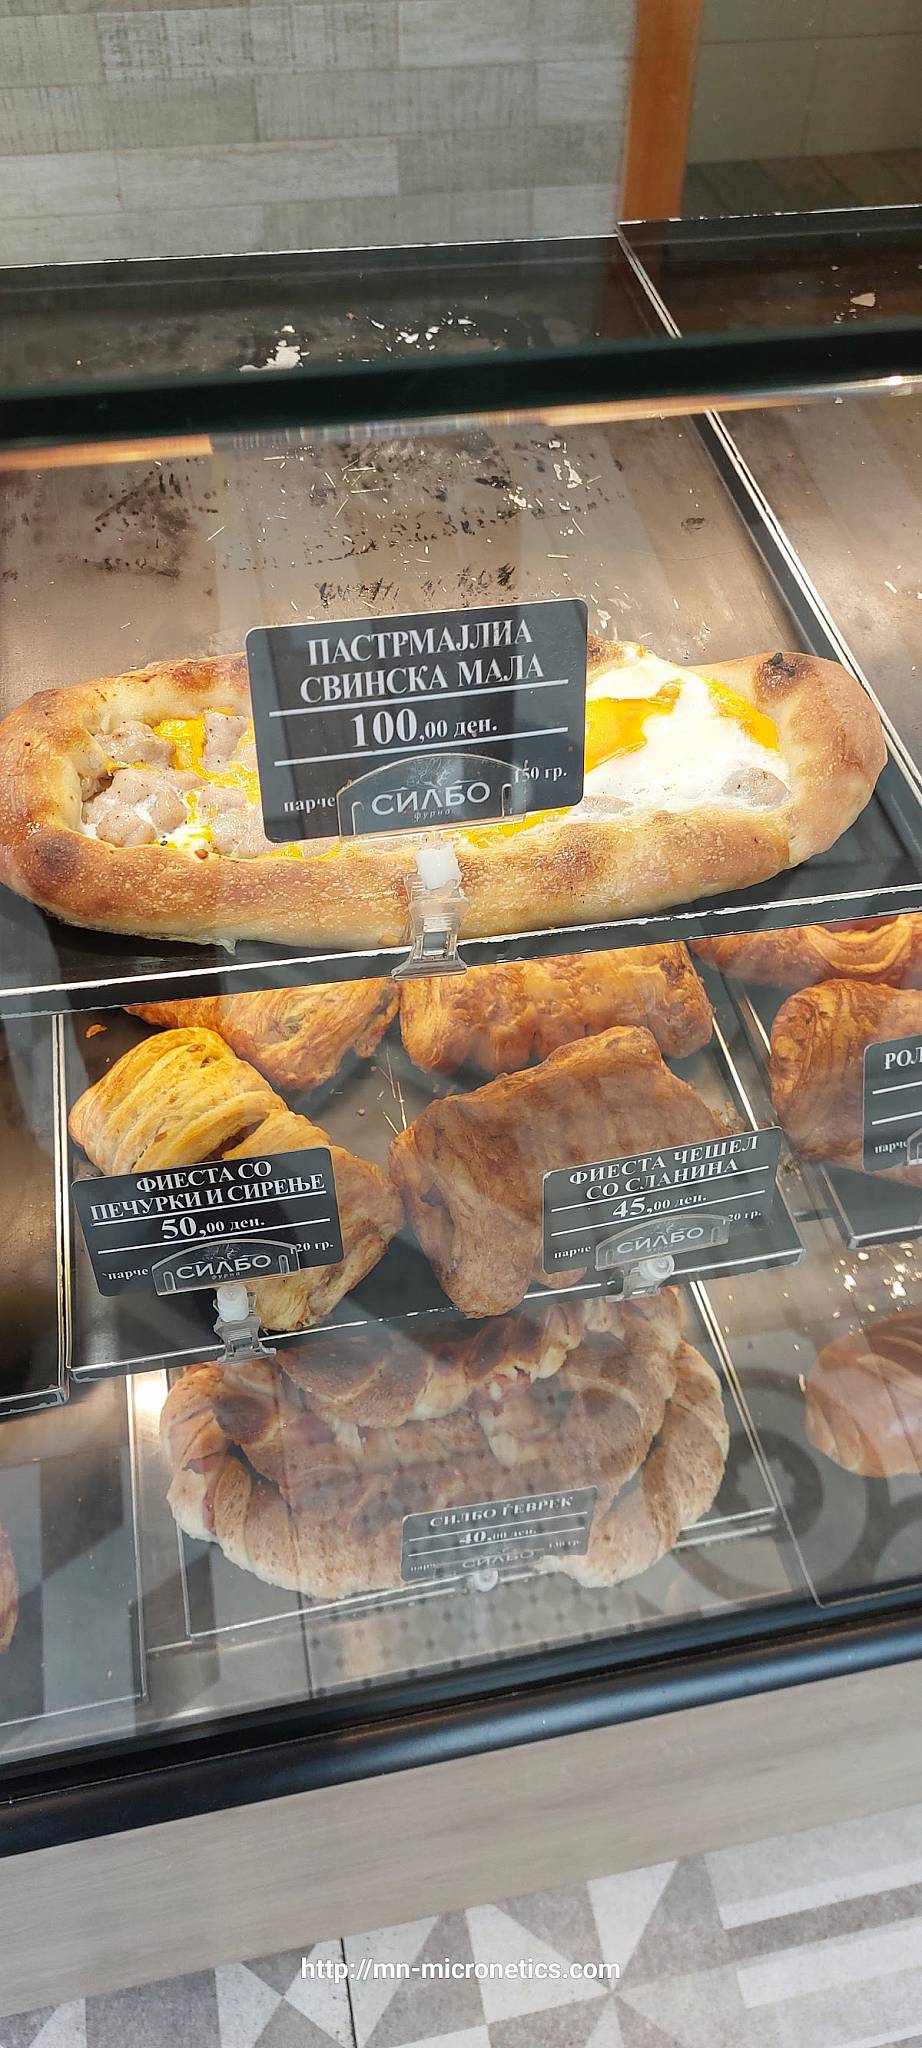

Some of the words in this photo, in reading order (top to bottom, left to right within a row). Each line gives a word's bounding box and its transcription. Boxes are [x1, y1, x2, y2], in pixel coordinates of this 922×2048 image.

[306, 619, 534, 666] ПАСТРМАЈЛИА
[300, 664, 449, 704] СВИНСКА
[457, 653, 545, 687] МАЛА
[352, 708, 448, 748] 100,00
[453, 717, 498, 738] ден.
[544, 765, 568, 782] гр.
[283, 796, 337, 816] парче
[371, 781, 491, 816] СИЛБО
[569, 1156, 667, 1186] ФИЕСТА
[673, 1135, 759, 1164] ЧЕШЕЛ
[136, 1168, 236, 1194] ФИЕСТА
[238, 1160, 272, 1180] СО
[586, 1182, 619, 1200] СО
[625, 1159, 739, 1193] СЛАНИНА
[90, 1191, 203, 1221] ПЕЧУРКИ
[206, 1188, 226, 1205] И
[227, 1173, 326, 1203] СИРЕНЬЕ
[612, 1197, 671, 1218] 45,00
[674, 1194, 707, 1209] ден.
[161, 1216, 225, 1240] 50,00
[229, 1218, 265, 1232] ден.
[617, 1227, 704, 1254] СИЛБО
[176, 1254, 272, 1280] СИЛБО
[554, 1246, 592, 1260] парче
[430, 1508, 497, 1527] СИЛБО
